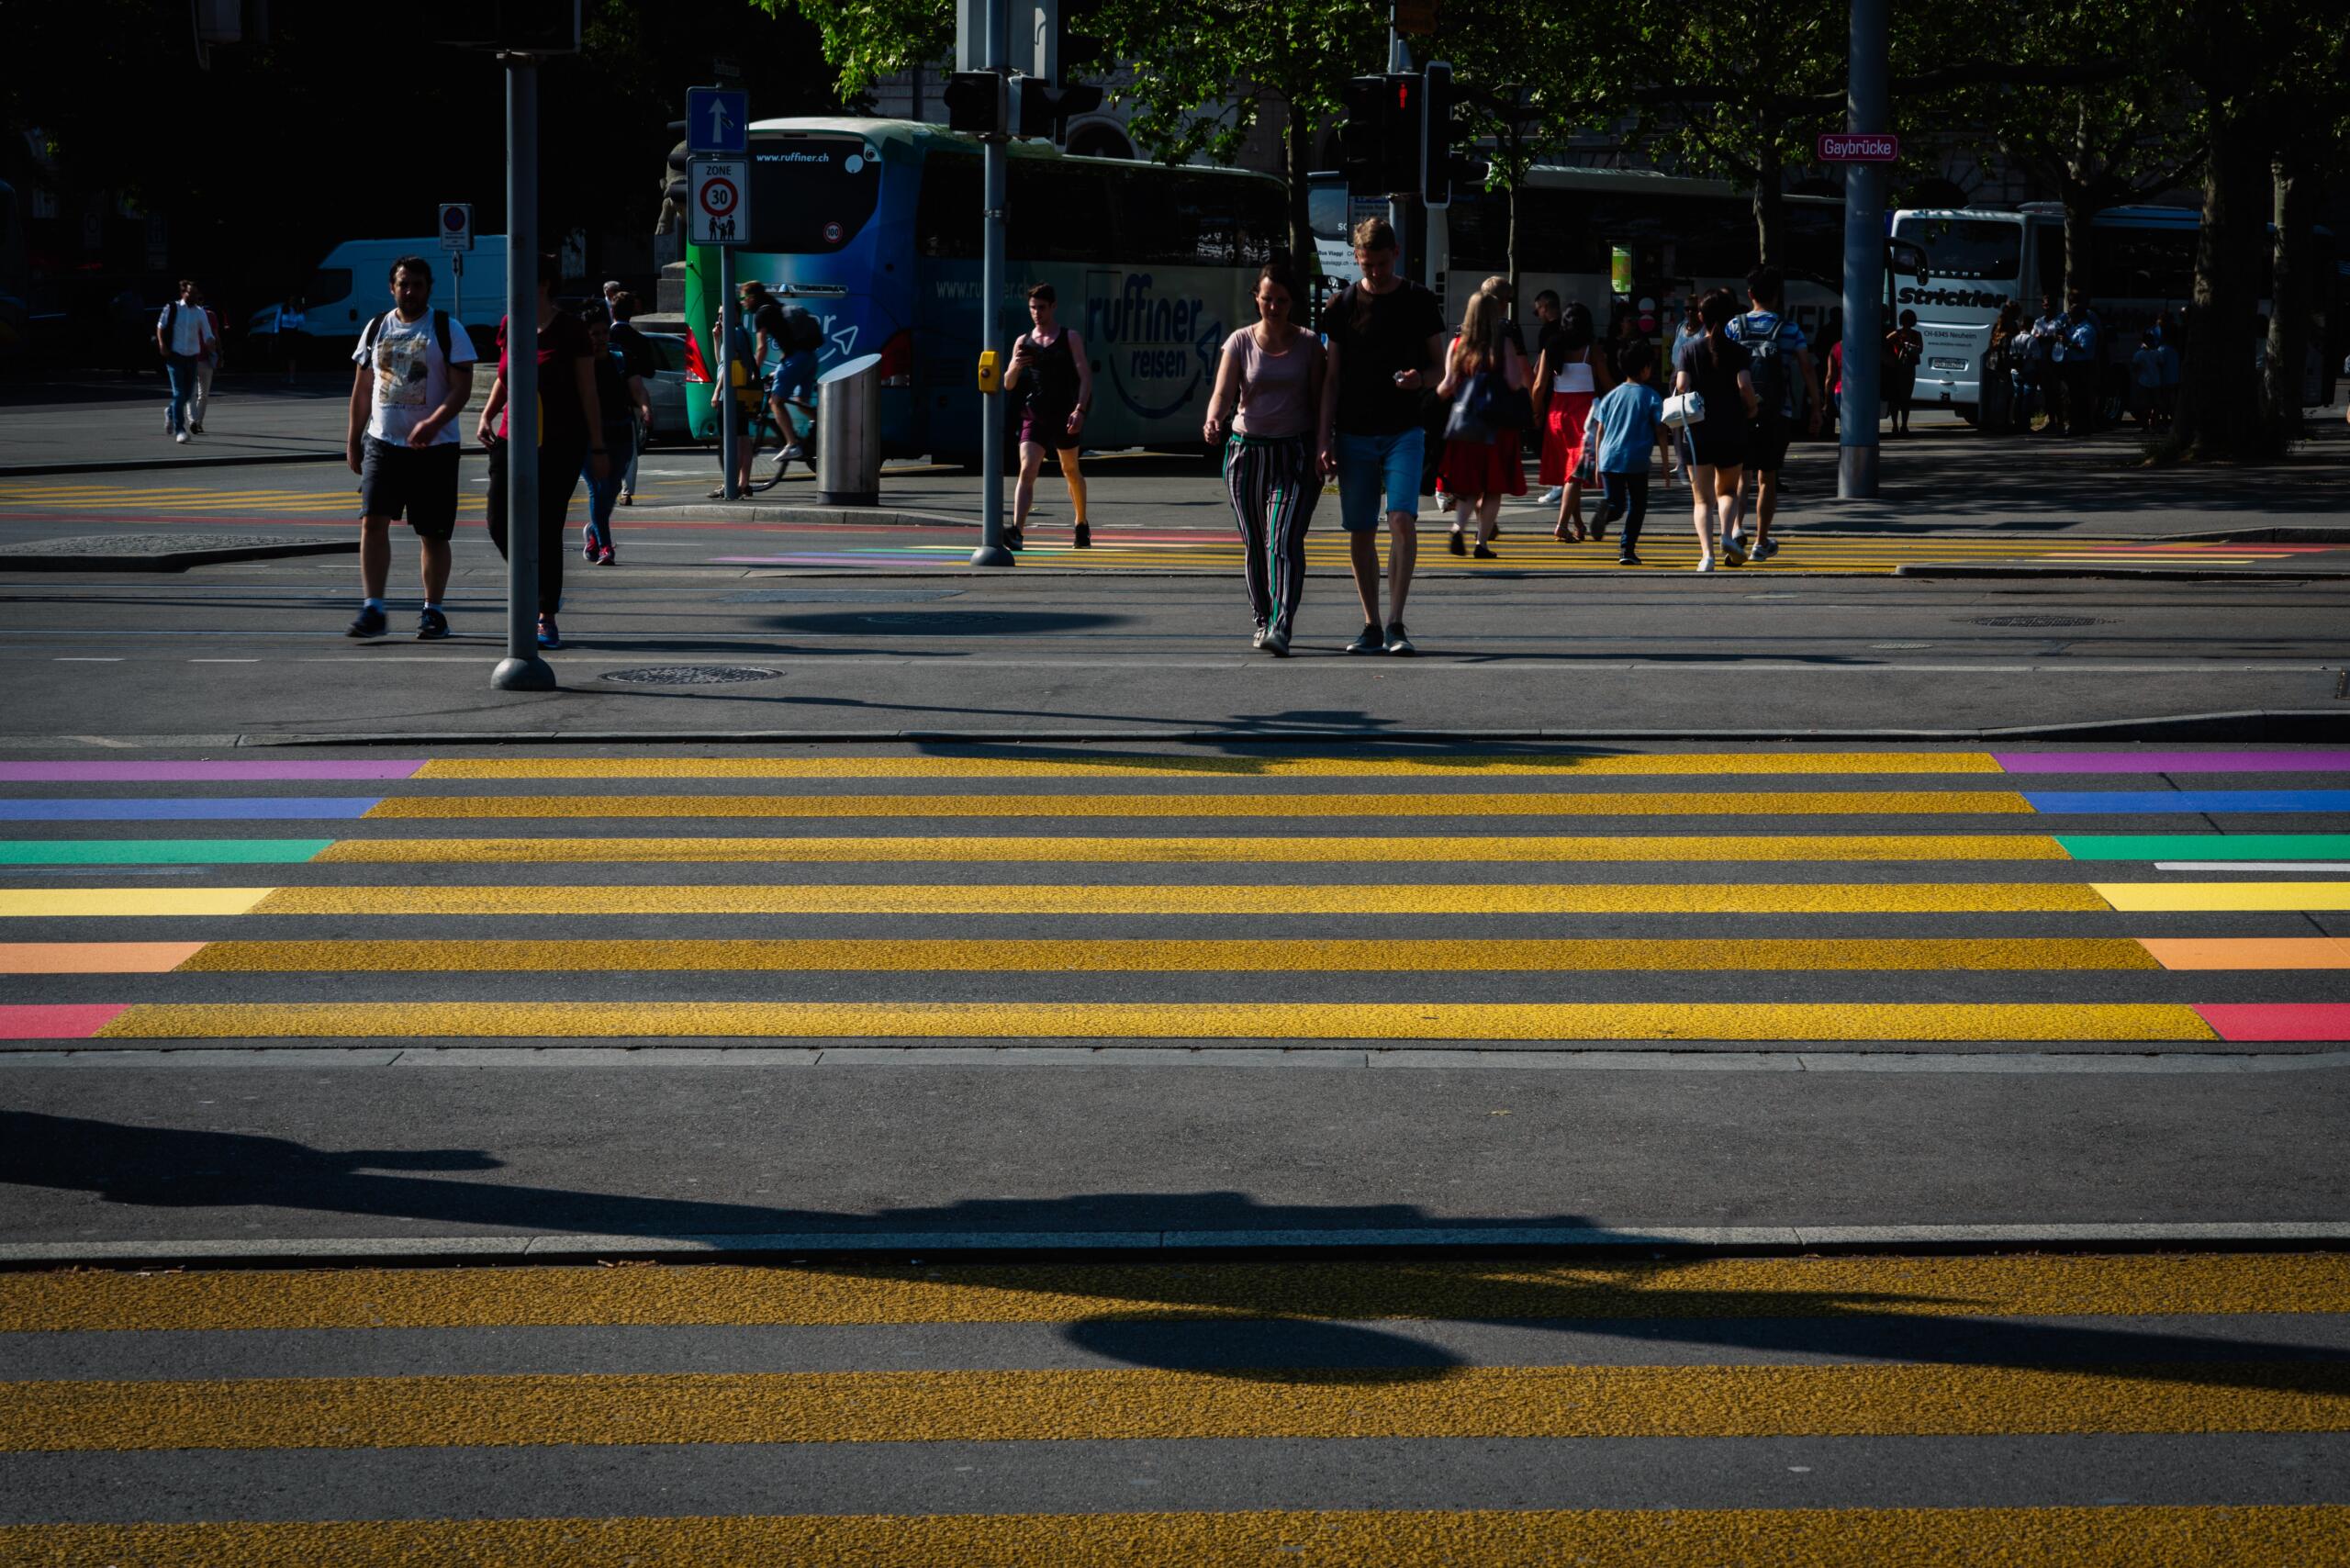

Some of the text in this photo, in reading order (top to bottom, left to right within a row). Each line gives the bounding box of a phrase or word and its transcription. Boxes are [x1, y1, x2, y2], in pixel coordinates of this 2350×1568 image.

[755, 151, 830, 162] www.ruffiner.ch
[1824, 139, 1891, 158] Gaybrücke
[706, 165, 732, 176] ZONE
[711, 189, 728, 205] 30
[827, 229, 839, 237] 100
[935, 274, 1030, 299] www.ruer.ch
[1897, 286, 2008, 308] Strickler
[1131, 348, 1186, 378] reisen
